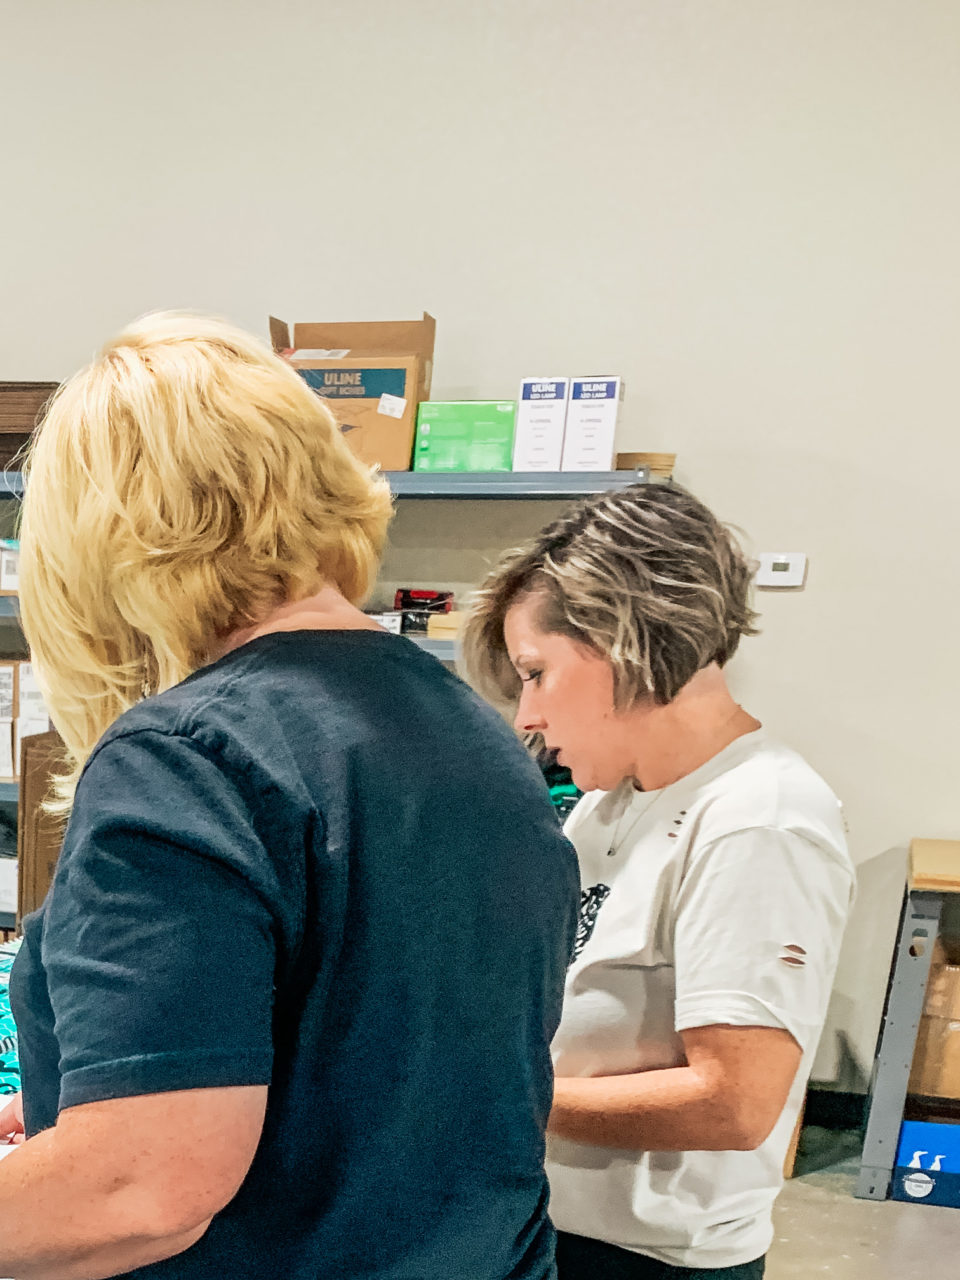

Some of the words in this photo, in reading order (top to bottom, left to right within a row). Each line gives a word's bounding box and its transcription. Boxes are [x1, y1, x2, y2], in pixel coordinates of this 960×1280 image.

[324, 372, 362, 386] ULINE
[531, 383, 557, 393] ULINE
[581, 382, 608, 392] ULINE
